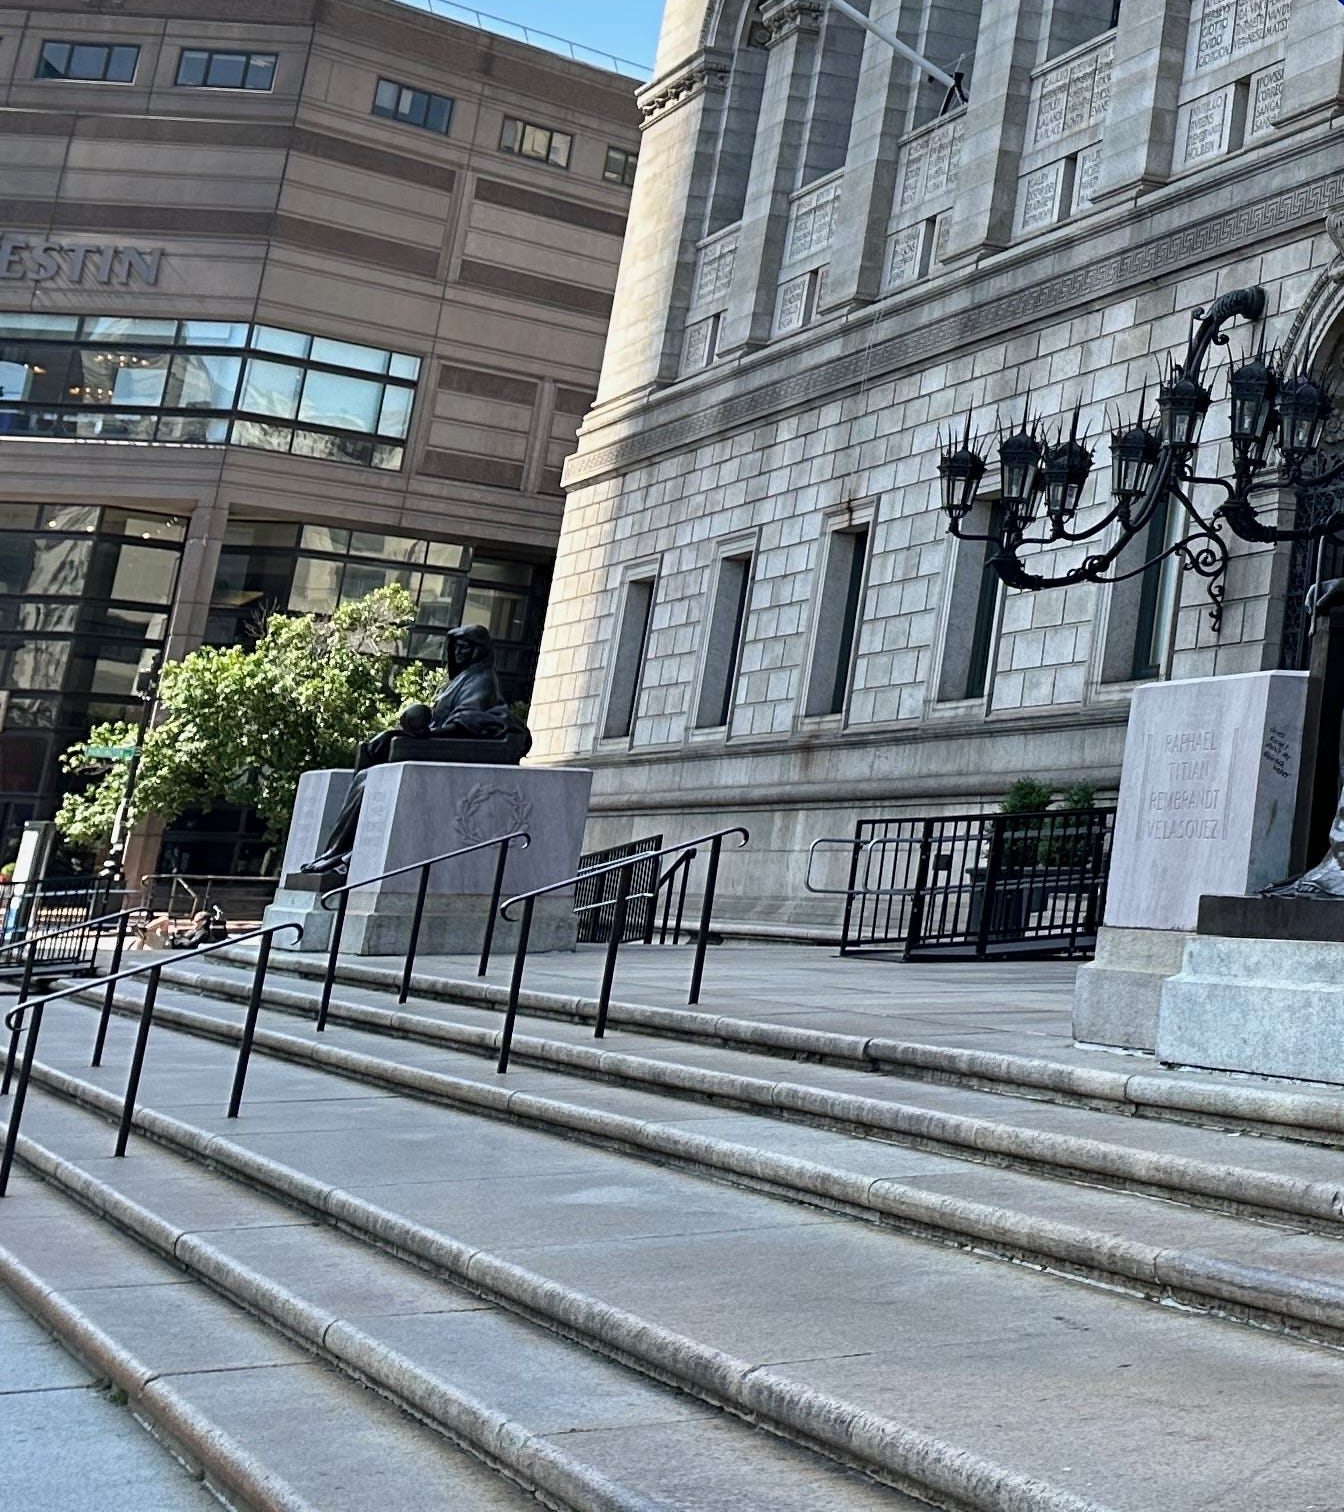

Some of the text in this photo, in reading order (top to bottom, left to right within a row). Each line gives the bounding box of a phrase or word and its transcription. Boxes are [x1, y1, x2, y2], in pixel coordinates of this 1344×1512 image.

[0, 240, 165, 285] ESTIN
[1165, 731, 1217, 752] RAPHAEL
[1169, 759, 1209, 781] TITIAN
[1149, 789, 1220, 810] REMBRANDT
